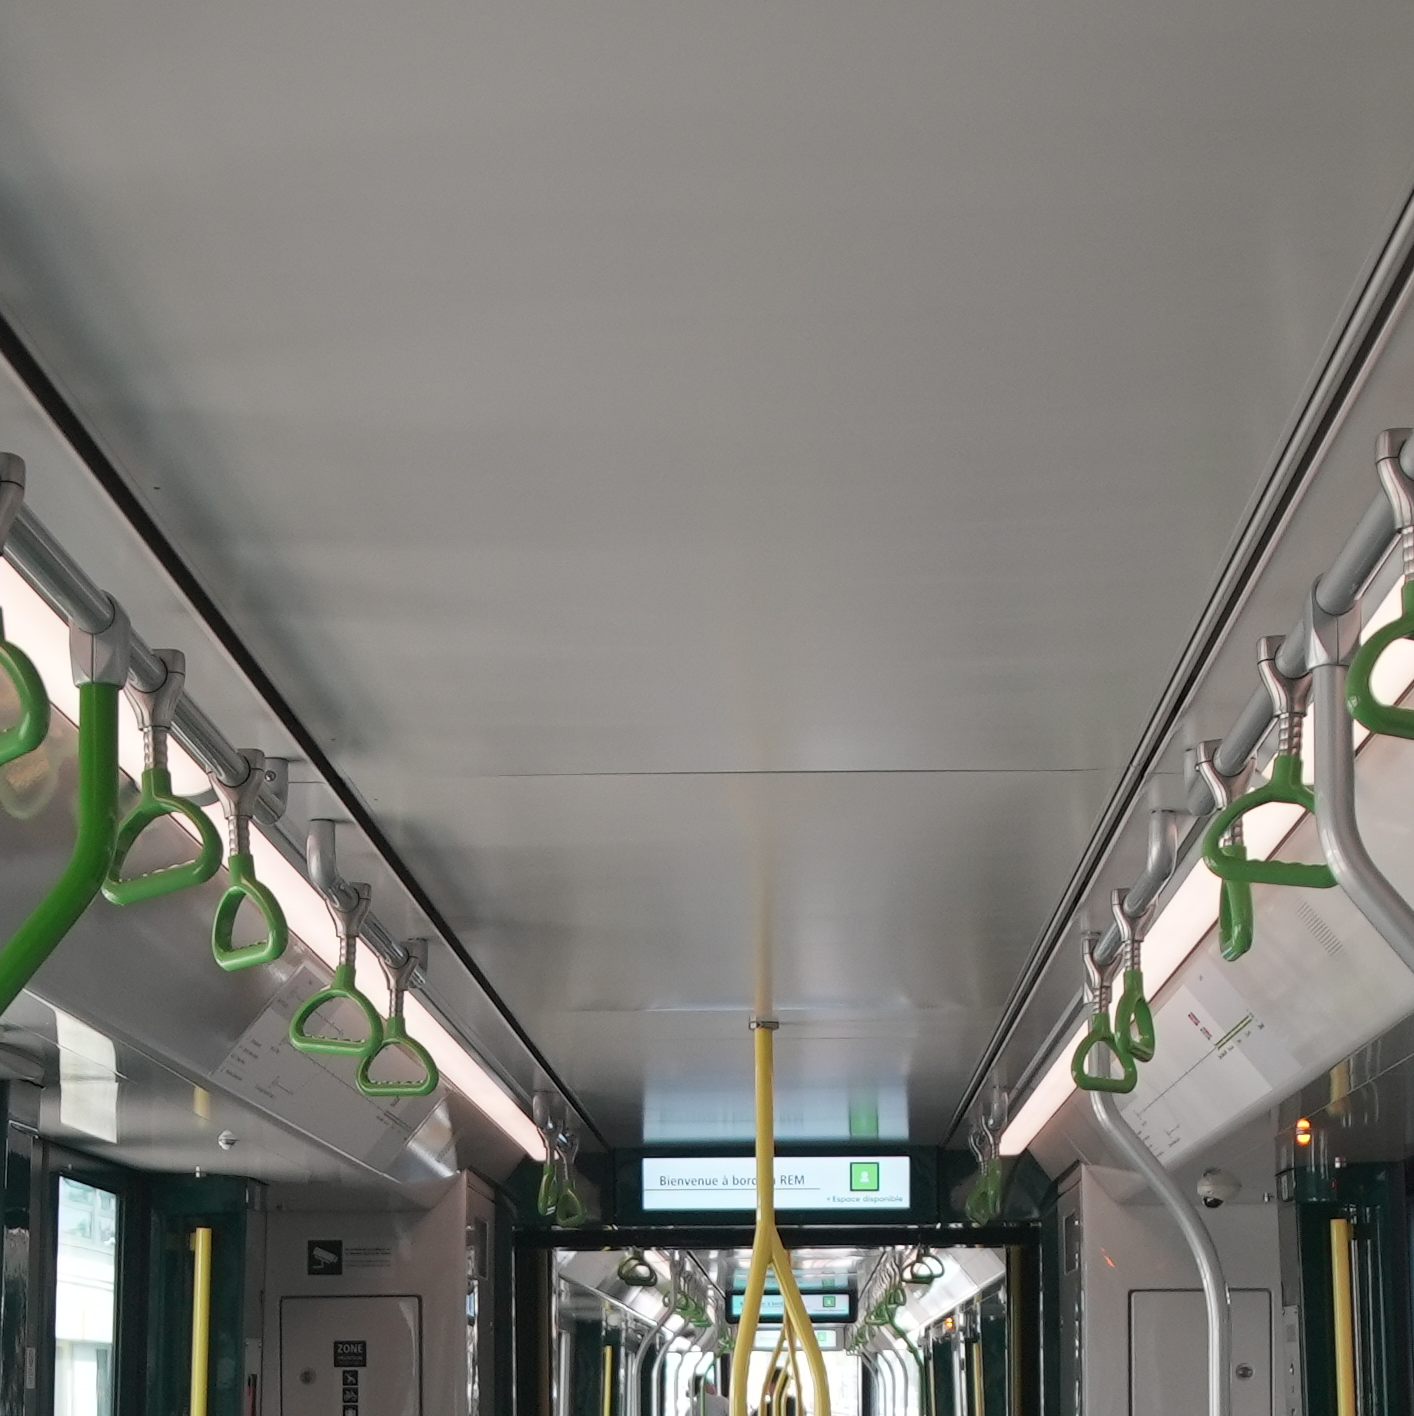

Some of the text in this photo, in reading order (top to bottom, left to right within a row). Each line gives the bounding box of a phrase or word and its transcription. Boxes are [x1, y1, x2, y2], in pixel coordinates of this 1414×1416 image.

[659, 1174, 718, 1187] Bienvenue
[722, 1174, 729, 1186] à
[780, 1175, 805, 1185] REM
[832, 1195, 860, 1204] Espace
[337, 1343, 363, 1354] ZONE
